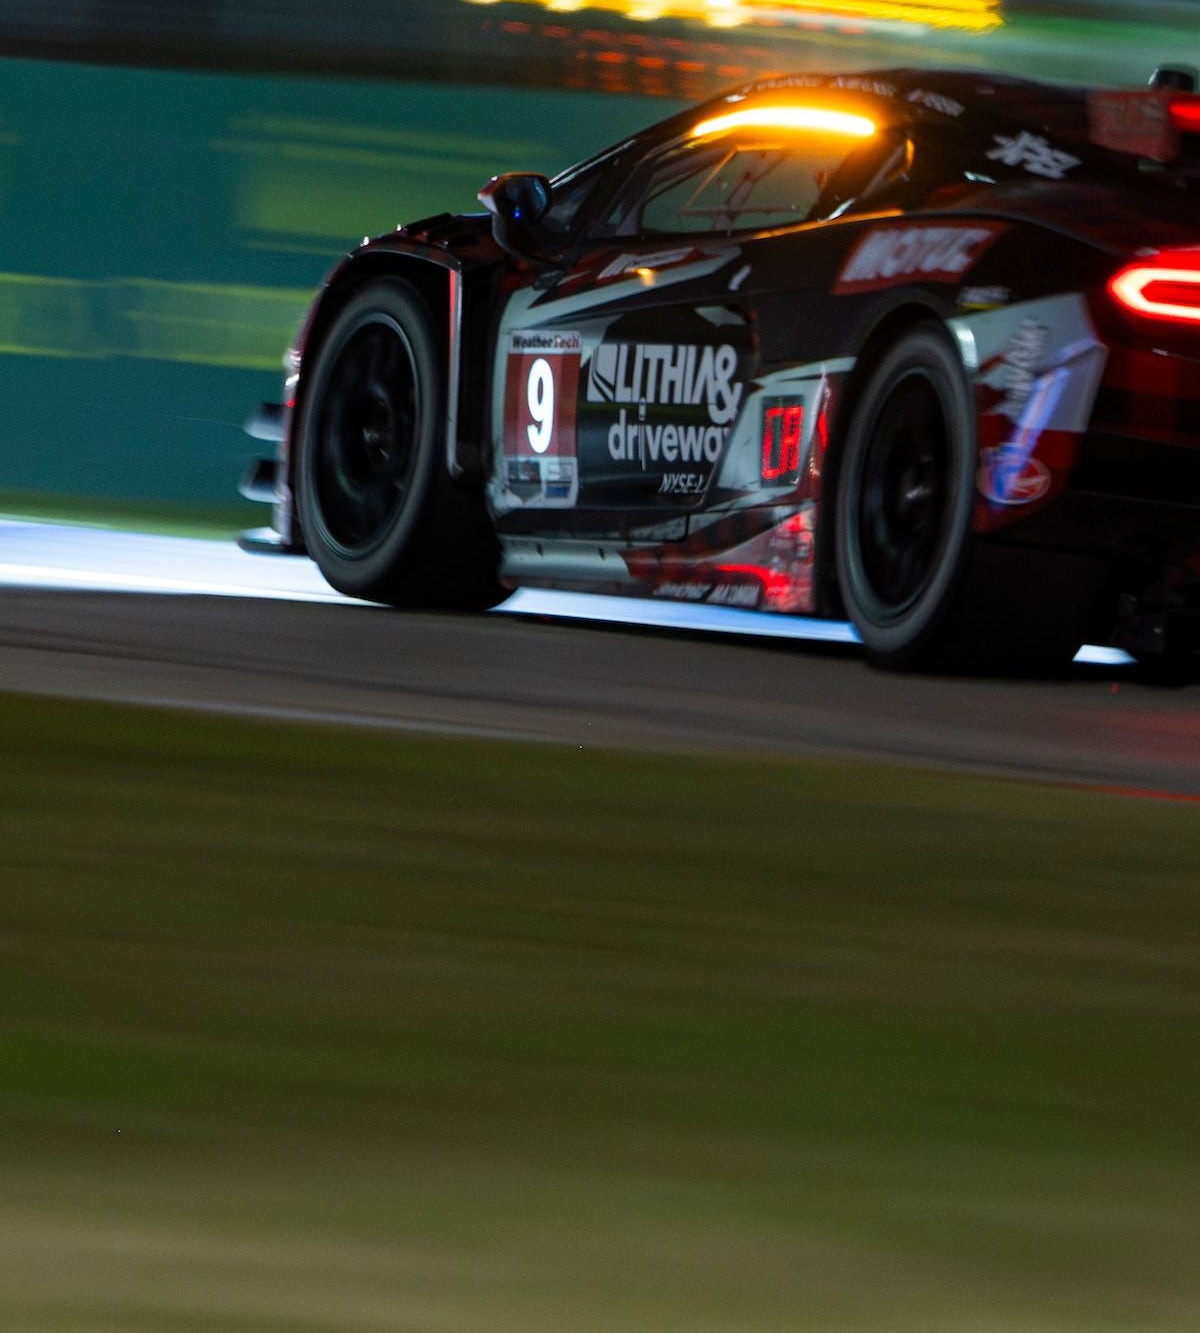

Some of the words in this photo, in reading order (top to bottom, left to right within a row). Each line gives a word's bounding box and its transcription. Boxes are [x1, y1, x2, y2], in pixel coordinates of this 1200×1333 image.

[512, 334, 580, 349] WeatherTech
[527, 358, 555, 454] 9
[608, 408, 729, 463] drivewa
